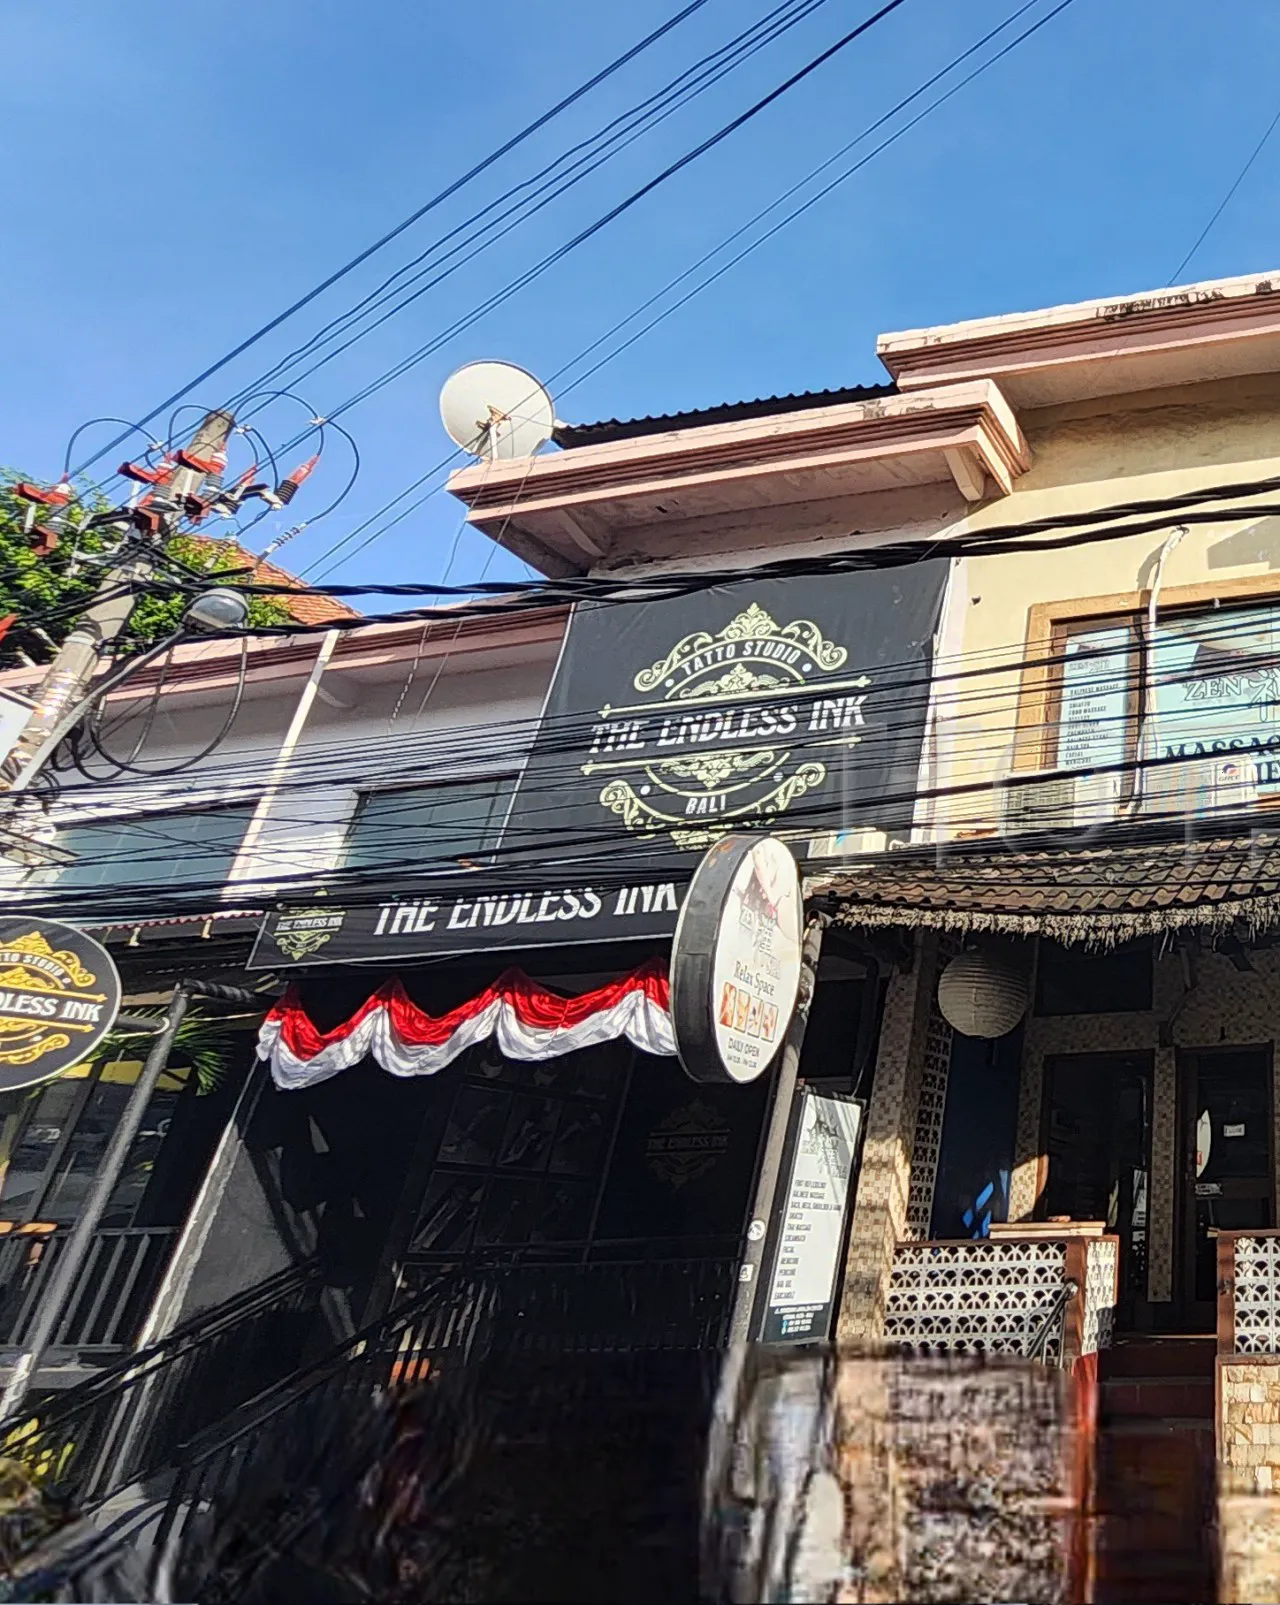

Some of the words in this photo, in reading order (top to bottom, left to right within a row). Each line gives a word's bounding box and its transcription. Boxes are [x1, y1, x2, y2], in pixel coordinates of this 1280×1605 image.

[682, 644, 736, 676] TATTO
[742, 640, 801, 664] STUDIO
[1183, 674, 1244, 702] ZEN
[589, 720, 650, 753] THE
[656, 705, 798, 747] ENDLESS
[808, 695, 868, 731] INK
[685, 794, 726, 815] BALI
[373, 896, 442, 935] THE
[446, 887, 601, 929] ENDLESS
[613, 882, 678, 915] INK
[22, 954, 65, 976] STUDIO
[734, 960, 753, 986] Relax
[754, 972, 775, 996] Space
[59, 1000, 104, 1022] INK
